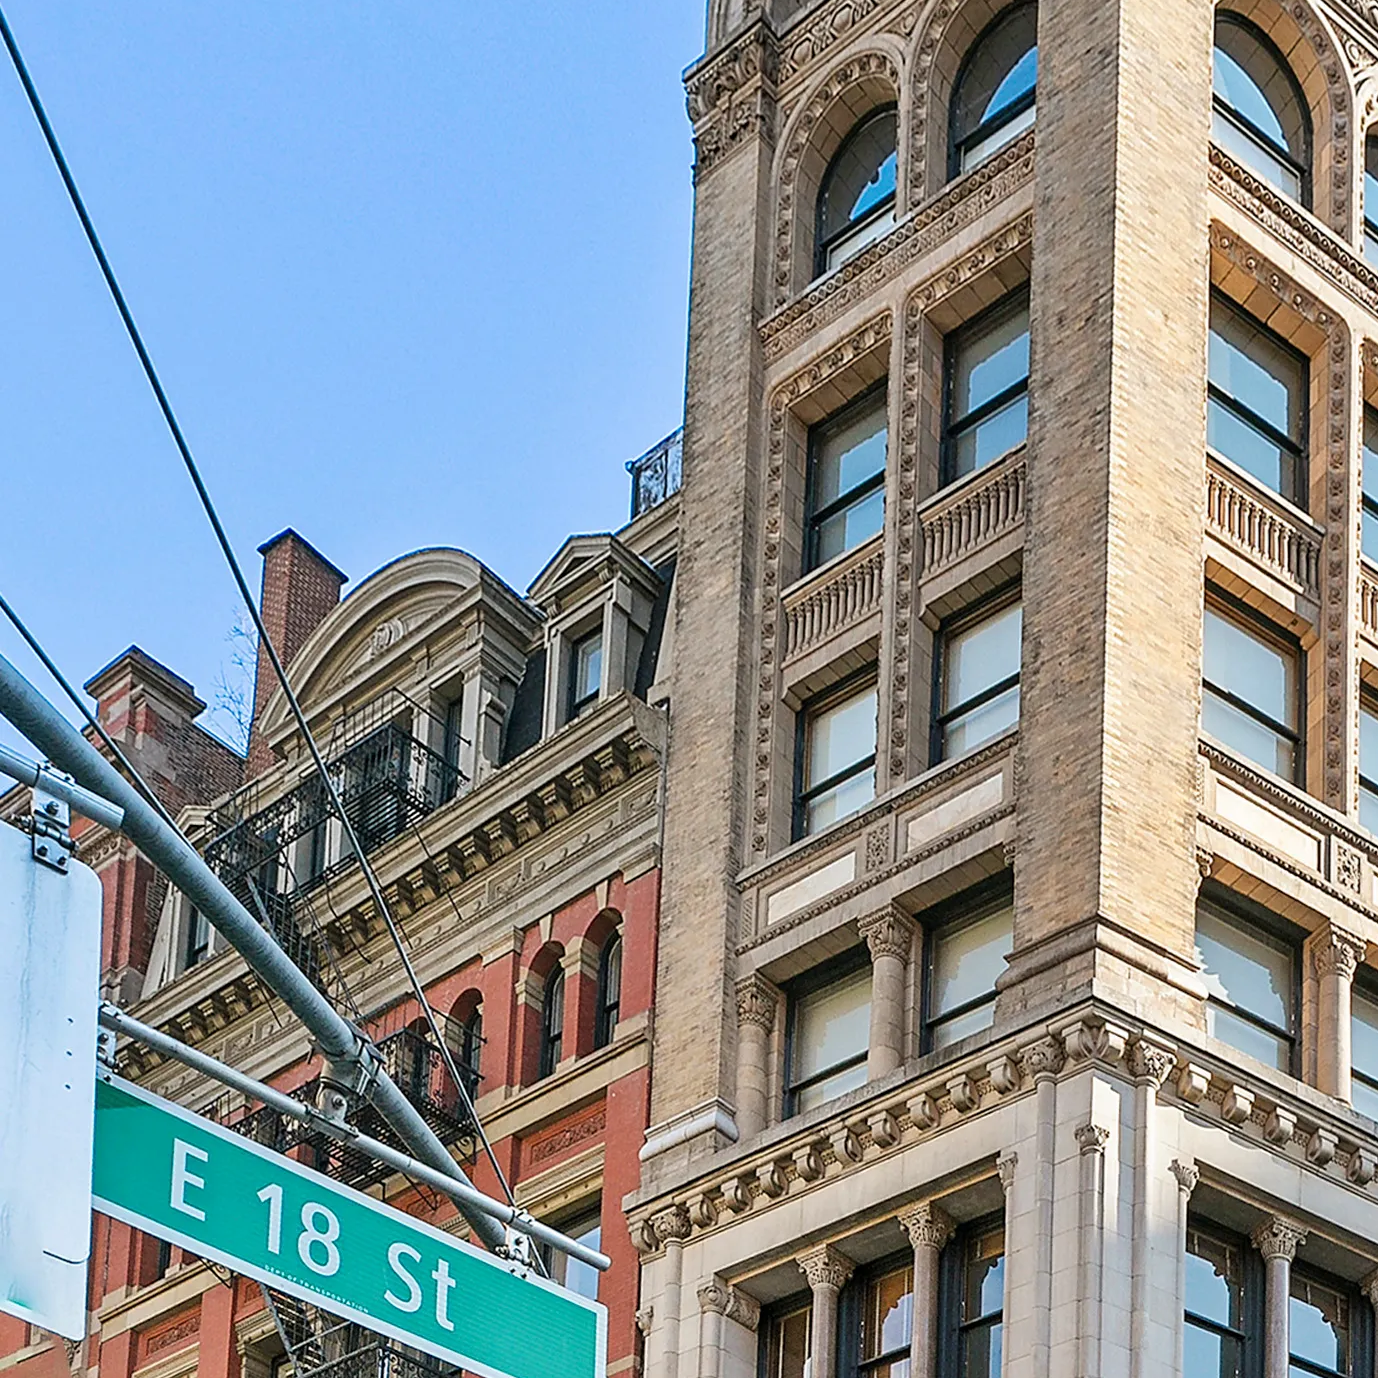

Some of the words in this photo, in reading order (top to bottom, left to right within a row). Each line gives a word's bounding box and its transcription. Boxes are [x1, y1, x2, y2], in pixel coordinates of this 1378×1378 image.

[170, 1137, 209, 1222] E
[256, 1183, 341, 1278] 18
[383, 1242, 457, 1332] St
